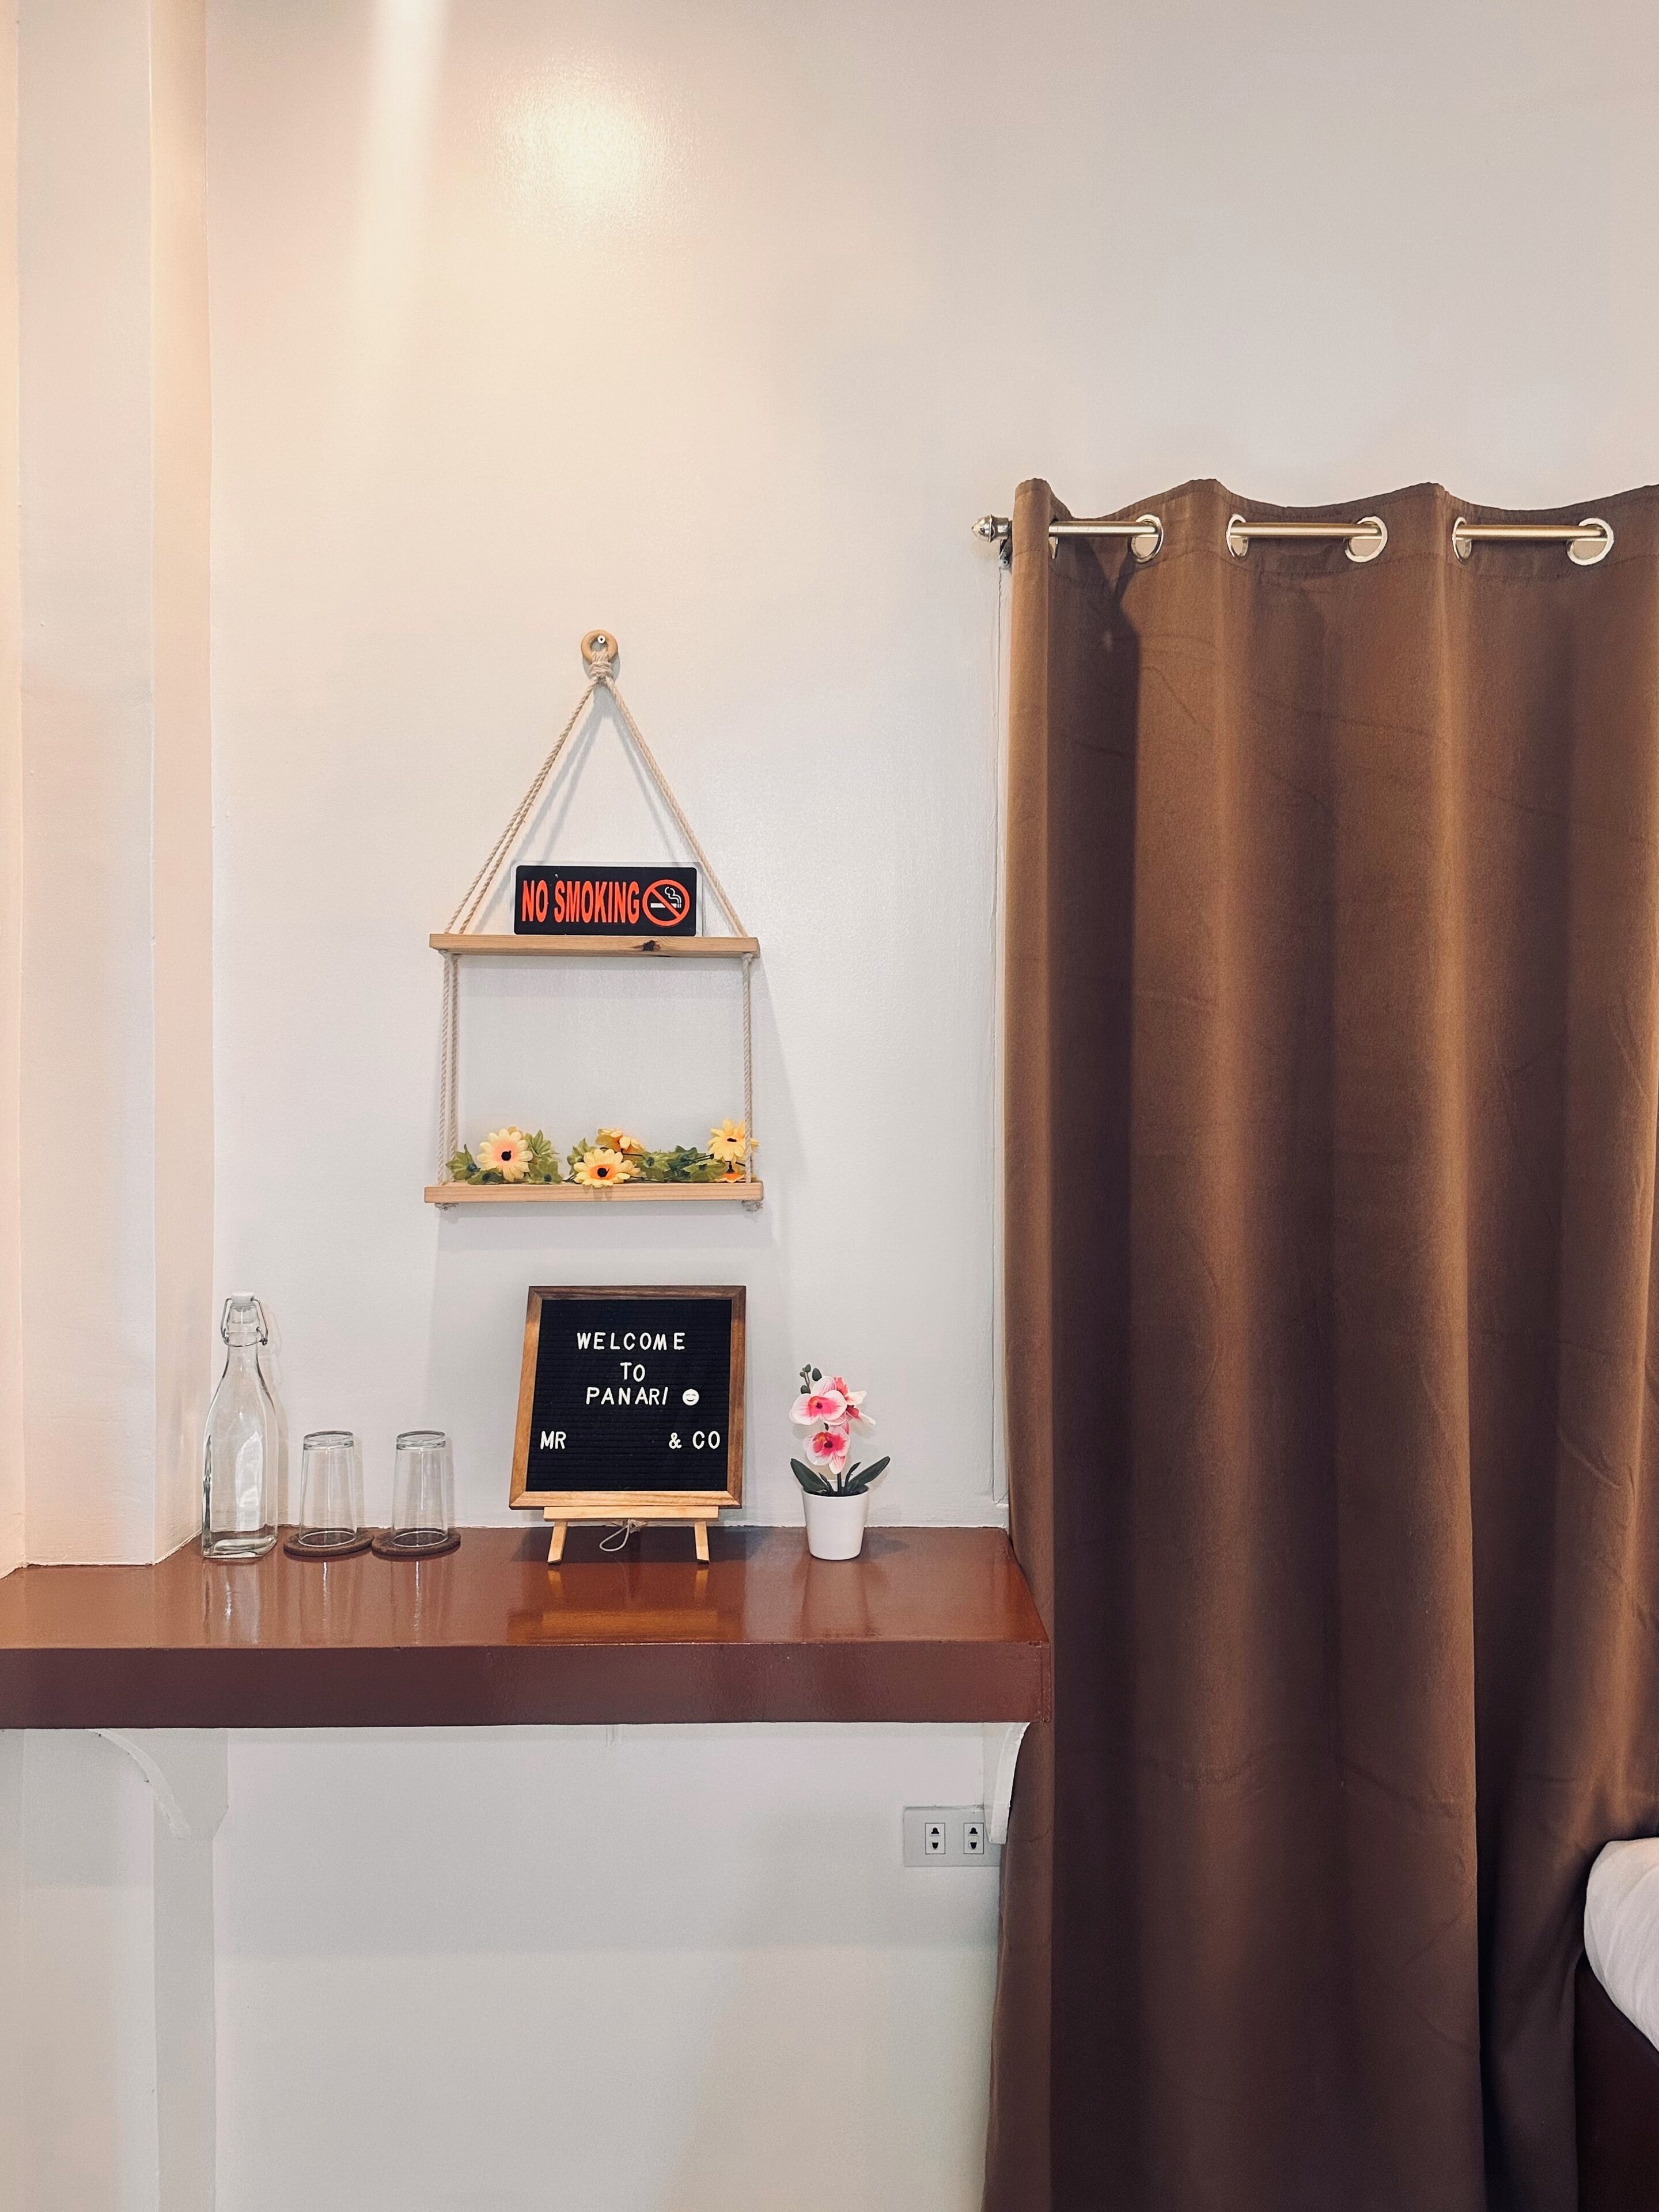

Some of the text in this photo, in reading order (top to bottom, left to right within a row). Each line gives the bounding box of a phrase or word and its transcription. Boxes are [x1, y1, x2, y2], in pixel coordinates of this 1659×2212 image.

[521, 880, 640, 925] NO SMOKING
[577, 1332, 685, 1351] WELCOME
[620, 1362, 646, 1382] TO
[586, 1387, 668, 1405] PANARI
[540, 1430, 721, 1450] MR & CO
